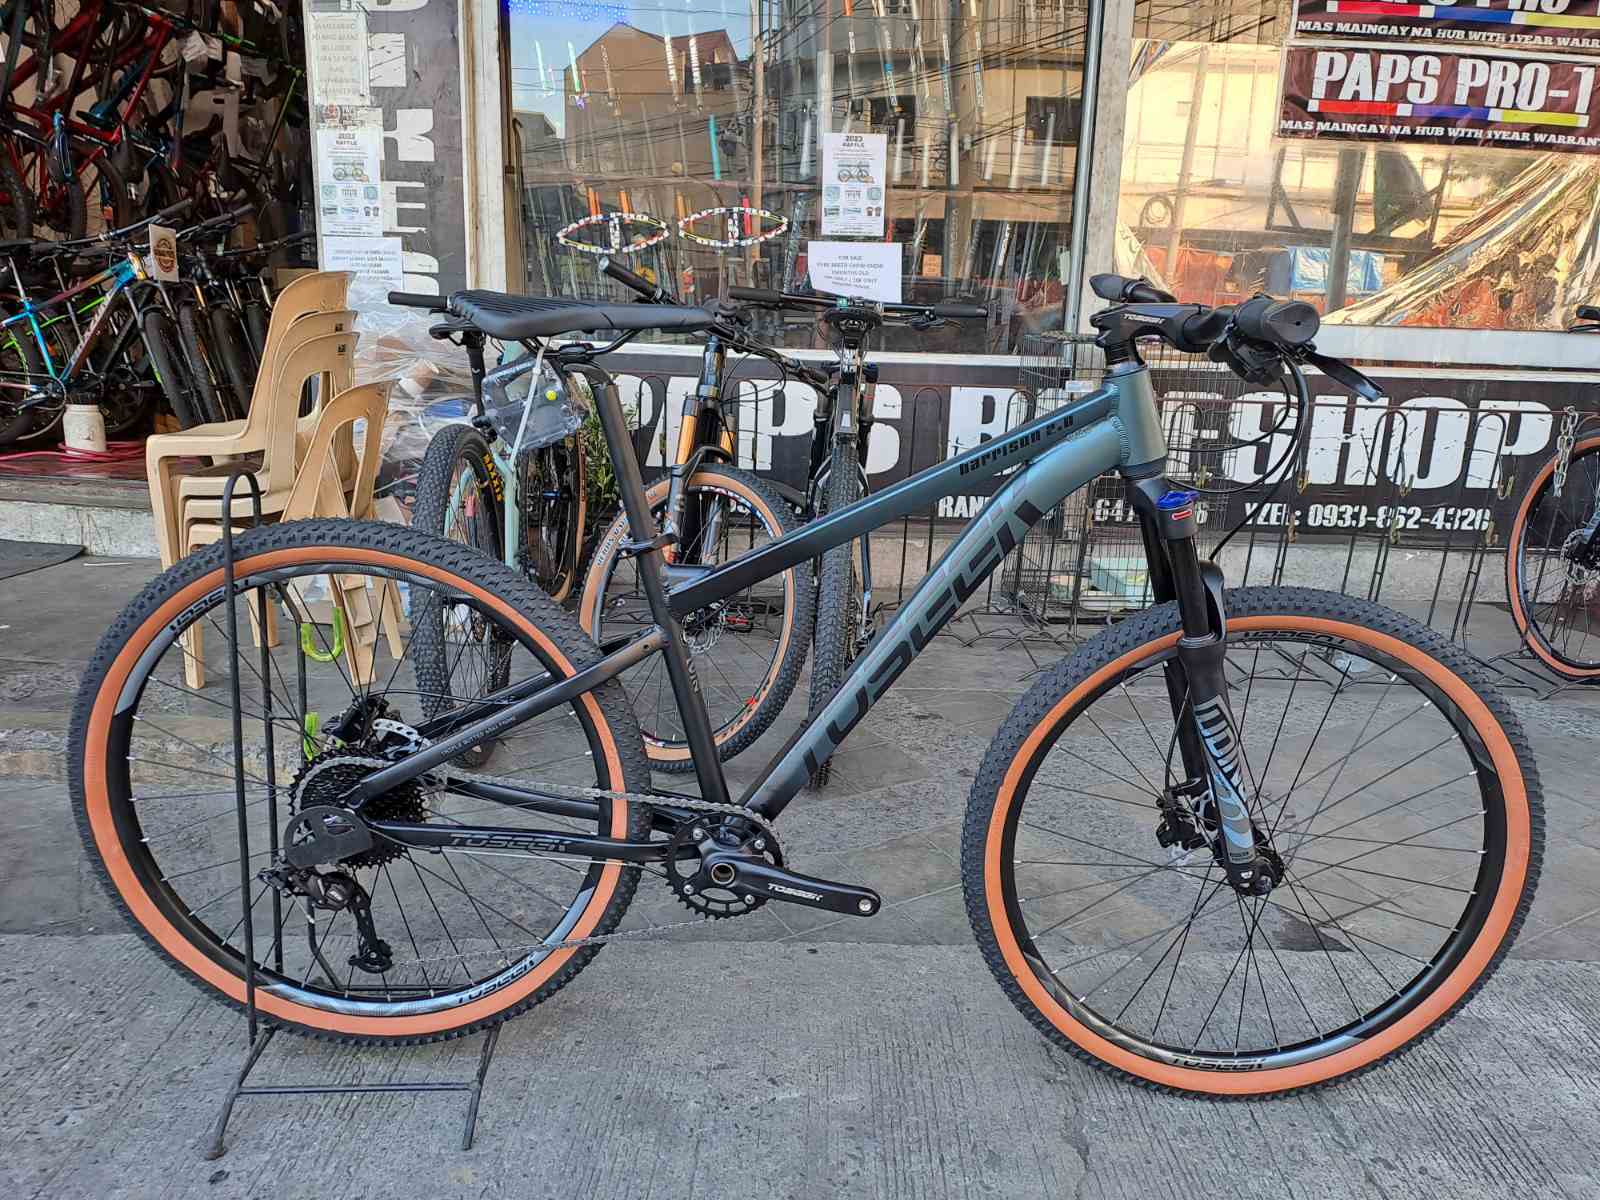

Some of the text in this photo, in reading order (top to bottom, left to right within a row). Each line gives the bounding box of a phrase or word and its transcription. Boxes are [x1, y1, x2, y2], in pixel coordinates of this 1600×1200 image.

[1297, 20, 1334, 32] MAS
[1335, 22, 1409, 37] MAINGAY
[1410, 26, 1433, 38] NA
[1436, 28, 1466, 40] HUB
[1468, 30, 1506, 43] WITH
[1311, 50, 1595, 115] PAPS PRO-1
[1280, 119, 1314, 131] MAS
[1316, 121, 1388, 135] MAINGAY
[1389, 125, 1412, 135] NA
[1414, 126, 1445, 137] HUB
[1447, 127, 1483, 139] WITH
[1534, 132, 1600, 147] WARRAN
[1222, 390, 1554, 491] SHOP
